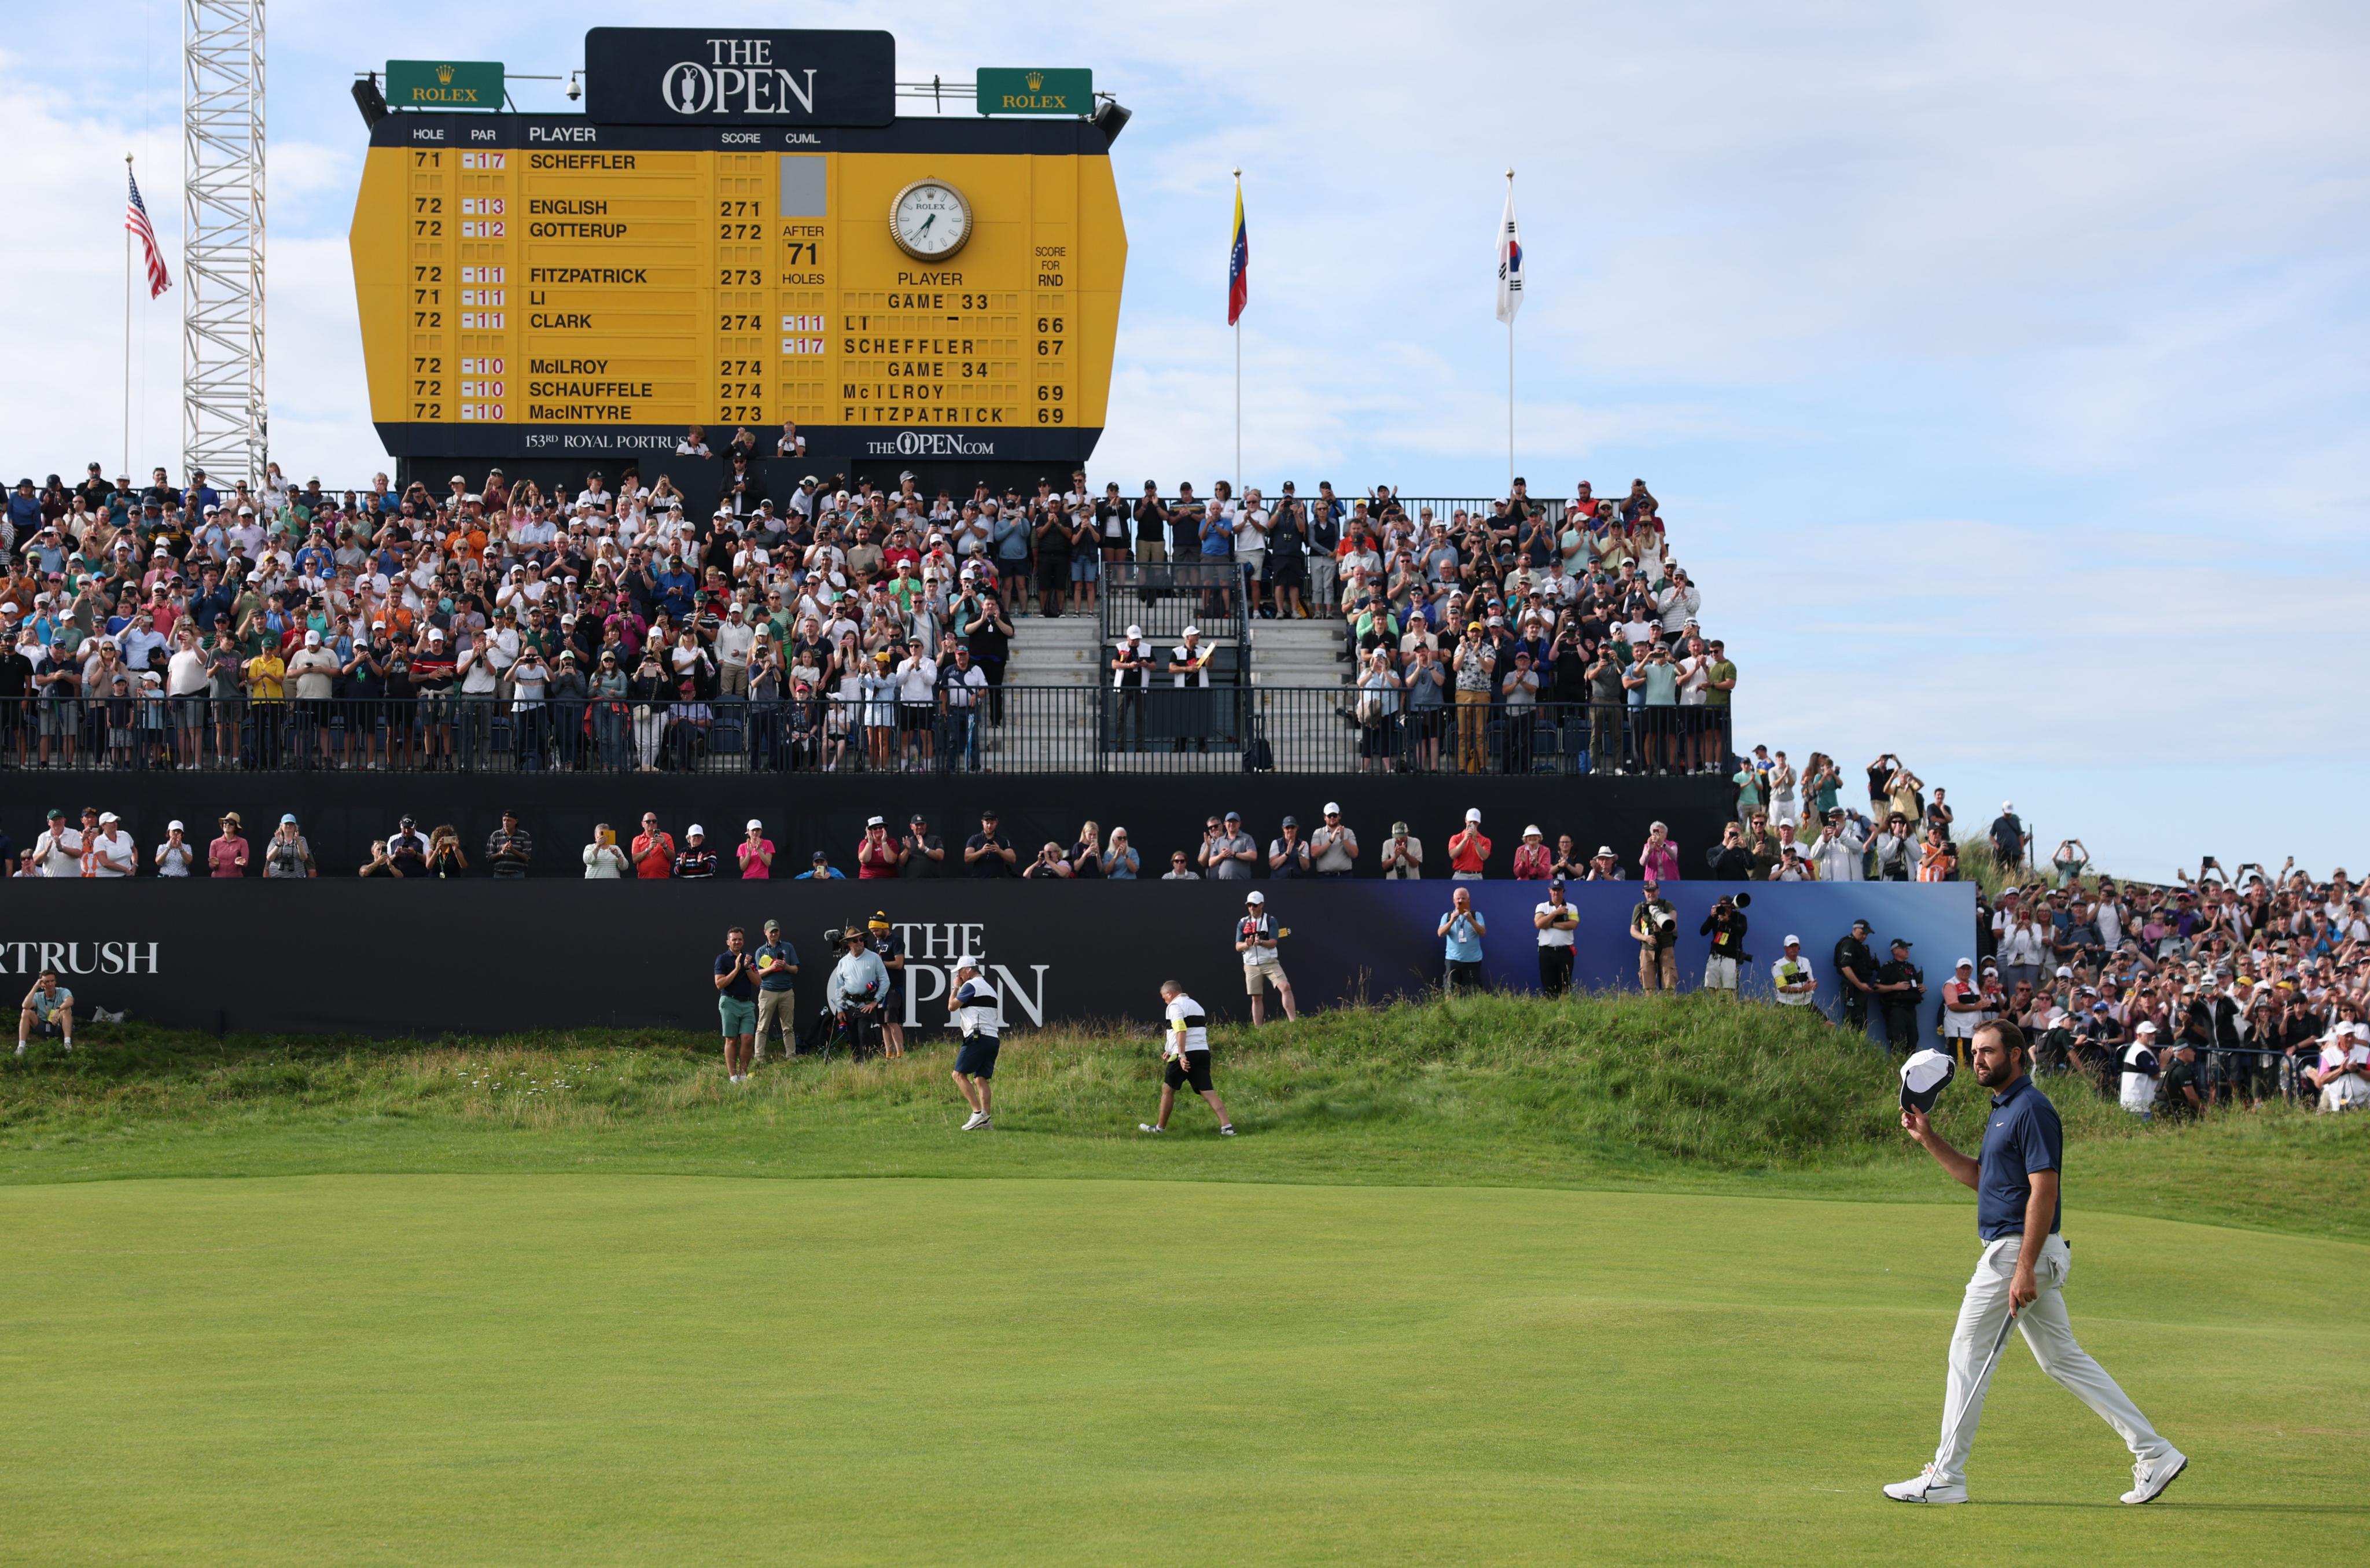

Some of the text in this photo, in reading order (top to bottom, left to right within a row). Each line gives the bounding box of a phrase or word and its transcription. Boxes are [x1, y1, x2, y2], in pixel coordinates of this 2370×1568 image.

[706, 39, 772, 65] THE
[413, 88, 477, 101] ROLEX
[662, 61, 817, 114] OPEN
[1003, 95, 1066, 108] ROLEX
[413, 129, 444, 139] HOLE
[471, 130, 496, 140] PAR
[529, 127, 596, 141] PLAYER
[722, 133, 761, 143] SCORE
[785, 133, 821, 143] CUML.
[415, 152, 635, 170] 71 -17 SCHEFFLER
[415, 197, 759, 217] 72 -13 ENGLISH 271
[415, 220, 761, 240] 72 -12 GOTTERUP 272
[783, 226, 824, 237] AFTER
[787, 243, 816, 265] 71
[1035, 246, 1066, 257] SCORE
[1042, 260, 1059, 270] FOR
[415, 266, 761, 285] 72 -11 FITZPATRICK 273
[782, 273, 825, 285] HOLES
[898, 272, 962, 286] PLAYER
[1038, 274, 1063, 286] RND
[415, 289, 545, 305] 71 -11 LI
[888, 293, 988, 310] GAME 33
[415, 312, 761, 330] 72 -11 CLARK 274
[786, 315, 1063, 333] -11 LI 66
[785, 338, 1063, 356] -17 SCHEFFLER 67
[414, 358, 761, 376] 72 -10 McILROY 274
[888, 362, 988, 378] GAME 34
[414, 380, 761, 399] 72 -10 SCHAUFFELE 274
[844, 384, 1063, 401] McILROY 69
[414, 403, 761, 422] 72 -10 MacINTYRE 273
[845, 407, 1063, 424] FITZPATRICK 69
[565, 435, 613, 448] ROYAL
[617, 435, 689, 449] PORTRUS
[892, 923, 985, 959] THE
[826, 964, 1050, 1028] PN
